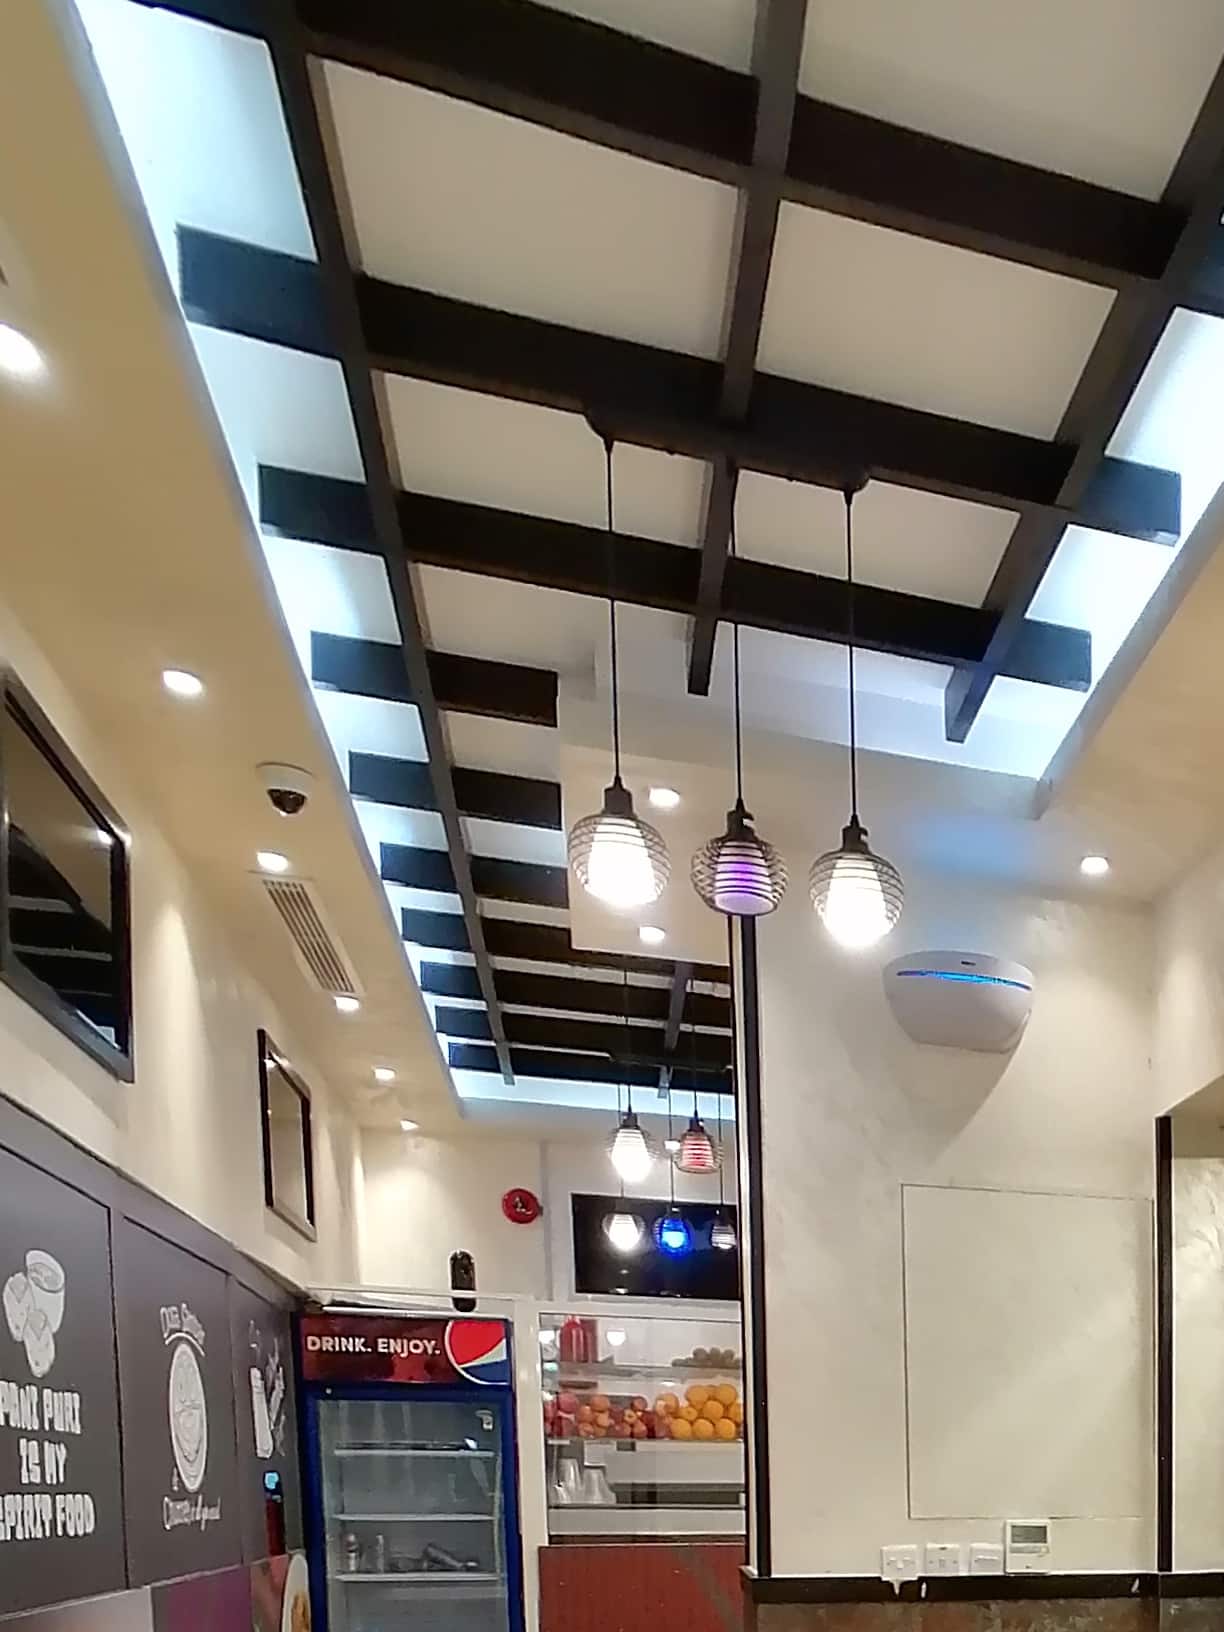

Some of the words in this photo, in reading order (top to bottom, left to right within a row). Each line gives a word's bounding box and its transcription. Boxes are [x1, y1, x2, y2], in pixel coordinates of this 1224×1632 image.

[306, 1335, 372, 1353] DRINK.
[377, 1338, 441, 1358] ENJOY.
[43, 1388, 81, 1434] PURI
[19, 1438, 41, 1484] IS
[44, 1440, 67, 1485] MY
[55, 1494, 96, 1537] FOOD
